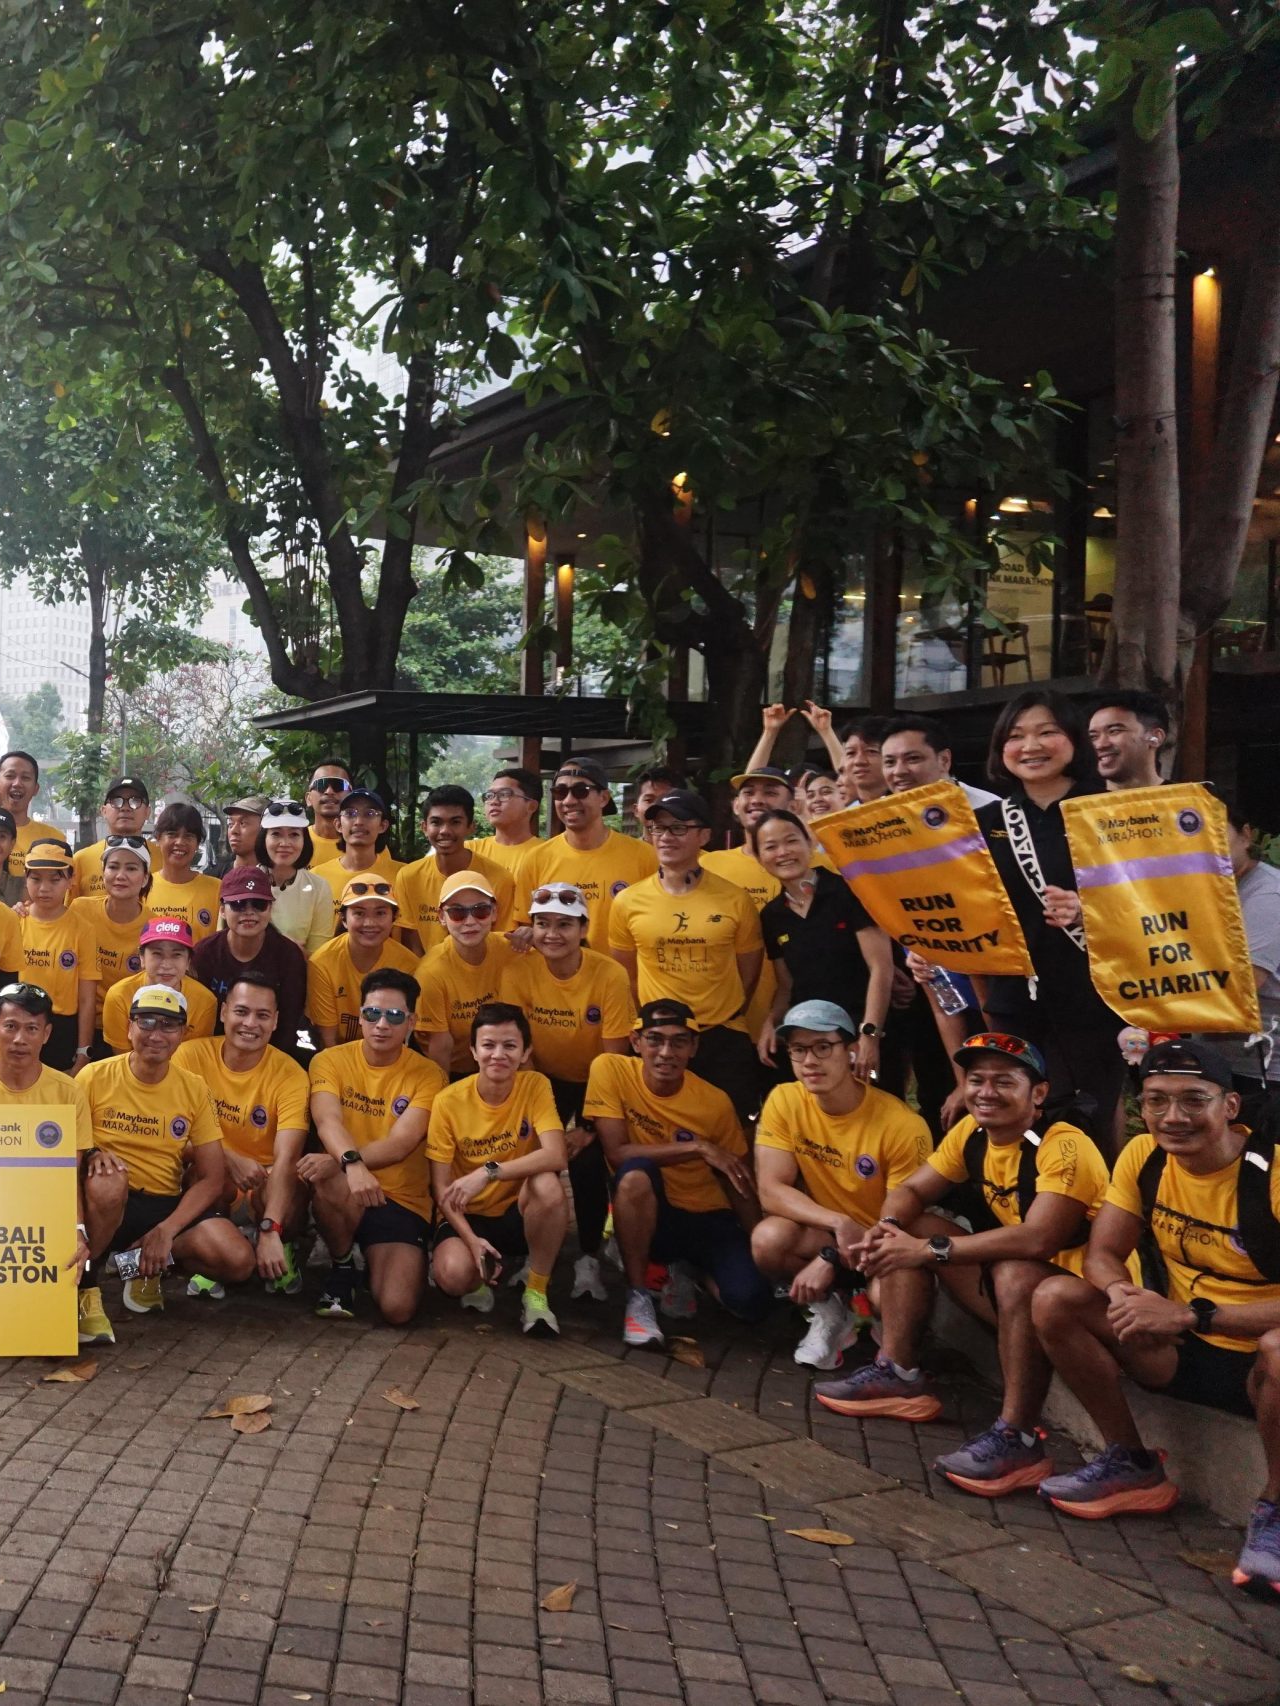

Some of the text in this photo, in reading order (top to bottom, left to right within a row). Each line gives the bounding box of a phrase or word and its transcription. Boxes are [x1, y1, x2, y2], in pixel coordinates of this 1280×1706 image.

[854, 817, 906, 837] Maybank
[1108, 814, 1160, 829] Maybank
[843, 828, 913, 849] MARATHON
[1098, 827, 1163, 845] MARATHON
[573, 881, 598, 890] bank
[745, 886, 768, 894] bank
[899, 893, 956, 912] RUN
[156, 922, 180, 933] ciele
[912, 917, 964, 933] FOR
[1141, 911, 1189, 936] RUN
[667, 937, 707, 945] Maybank
[898, 930, 1000, 953] CHARITY
[99, 947, 118, 957] bank
[657, 946, 708, 963] BALI
[1148, 942, 1194, 967] FOR
[1118, 970, 1231, 1000] CHARITY
[451, 1009, 479, 1020] MARA
[534, 1006, 575, 1018] Maybank
[215, 1099, 241, 1114] ybank
[354, 1091, 385, 1106] Maybank
[340, 1098, 386, 1117] MARATHON
[116, 1111, 159, 1125] Maybank
[217, 1108, 240, 1124] THON
[102, 1119, 159, 1136] MARATHON
[474, 1131, 512, 1147] Maybank
[461, 1141, 517, 1158] MARATHON
